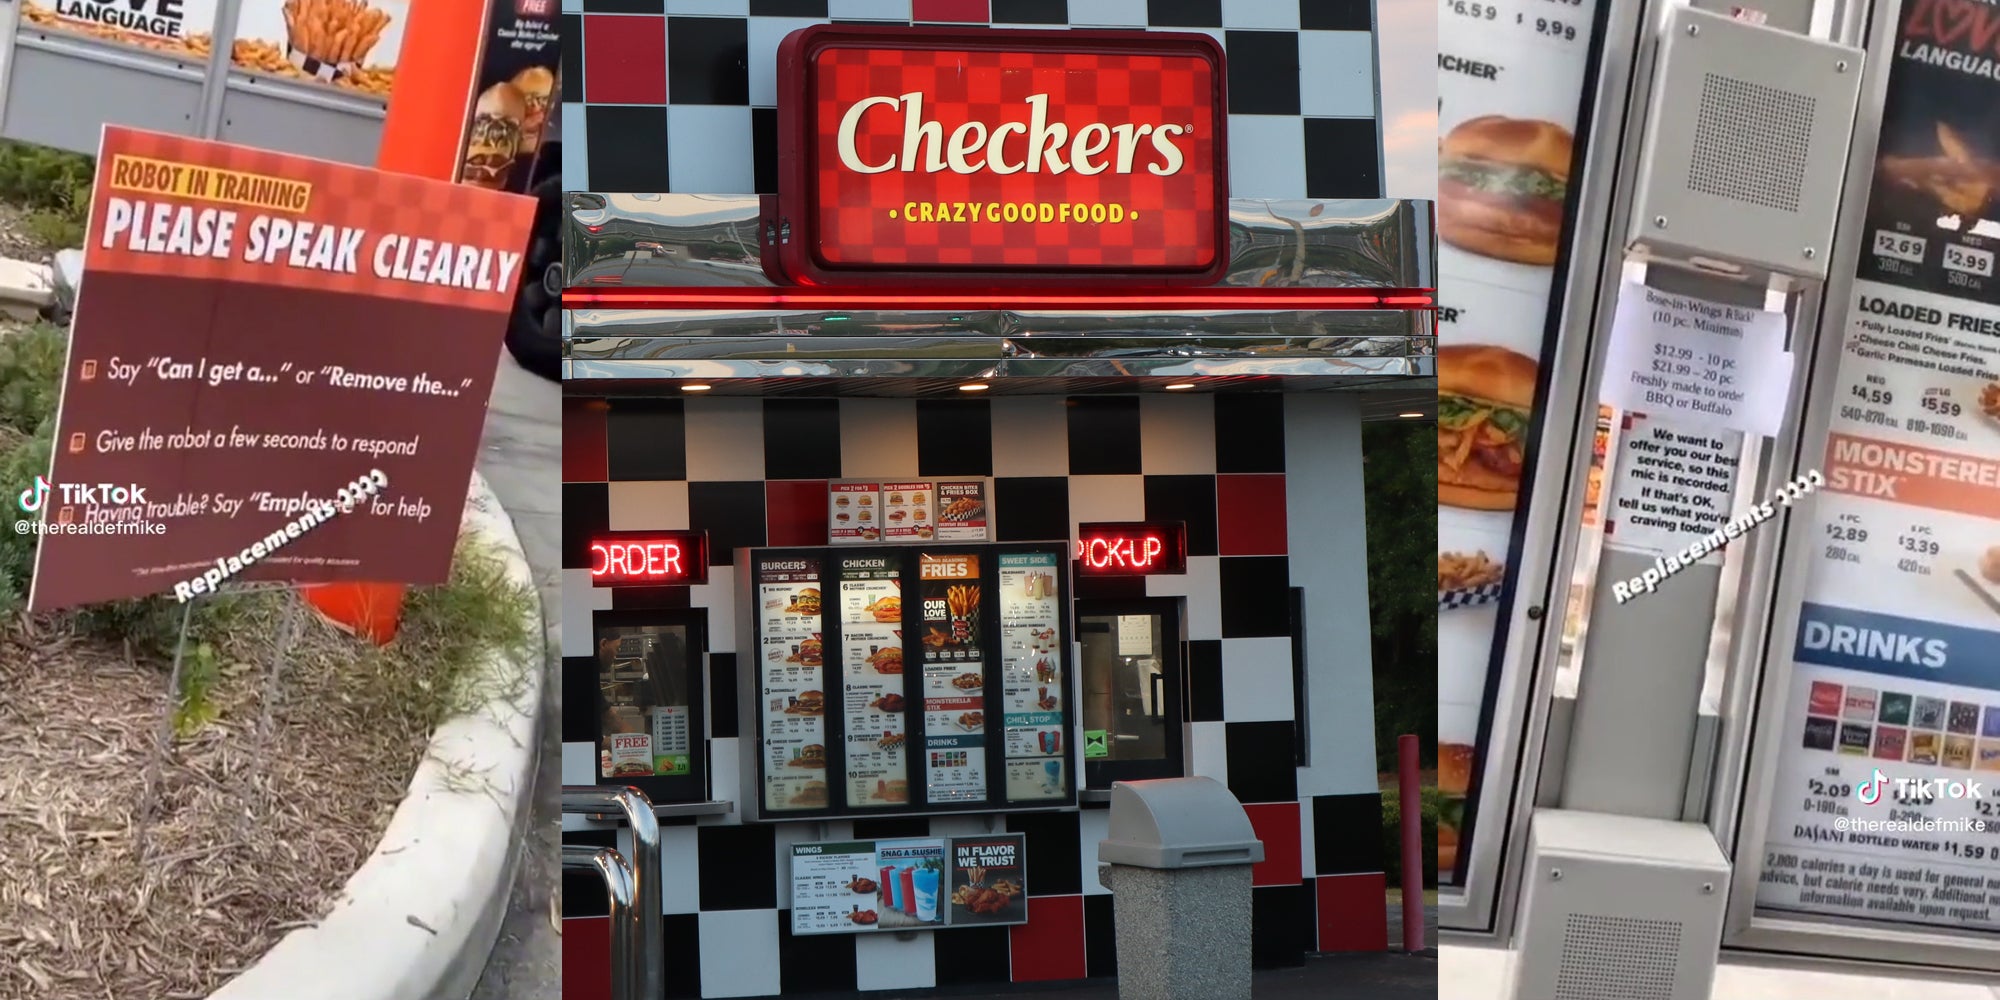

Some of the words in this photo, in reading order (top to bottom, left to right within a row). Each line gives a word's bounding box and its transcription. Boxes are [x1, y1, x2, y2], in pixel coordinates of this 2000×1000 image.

[56, 0, 181, 38] LANGUAGE
[114, 157, 182, 192] ROBOT
[187, 168, 208, 195] IN
[214, 172, 308, 210] TRAINING
[904, 202, 981, 222] CRAZY
[986, 202, 1055, 223] GOOD
[1059, 203, 1125, 223] FOOD
[102, 198, 236, 259] PLEASE
[245, 214, 366, 275] SPEAK
[373, 232, 521, 294] CLEARLY
[1880, 236, 1922, 255] $2.69
[1948, 249, 1987, 271] $2.99
[1859, 296, 1942, 325] LOADED
[1861, 320, 1885, 333] Fully
[1888, 325, 1922, 340] Loaded
[1654, 343, 1693, 360] $12.99
[1707, 353, 1721, 367] 10
[1859, 334, 1895, 348] Cheese
[1898, 340, 1920, 353] Chili
[1922, 346, 1958, 360] Cheese
[108, 356, 142, 386] Say
[197, 357, 206, 379] I
[208, 361, 244, 386] get
[296, 370, 315, 384] or
[1652, 359, 1690, 376] $21.99
[1703, 370, 1717, 382] 20
[1857, 348, 1886, 361] Garlic
[1888, 353, 1936, 369] Parmesan
[1938, 362, 1973, 377] Loaded
[1631, 371, 1668, 389] Freshly
[1672, 379, 1702, 395] made
[1704, 386, 1715, 397] to
[1646, 391, 1674, 408] BBQ
[1676, 397, 1689, 408] or
[1692, 400, 1732, 416] Buffalo
[1852, 385, 1892, 405] $4.59
[1922, 397, 1961, 417] $5.59
[96, 430, 135, 453] Give
[139, 426, 163, 450] the
[167, 426, 211, 449] robot
[214, 433, 226, 448] a
[229, 425, 259, 448] few
[263, 428, 327, 450] seconds
[332, 433, 347, 451] to
[352, 435, 419, 459] respond
[1630, 440, 1660, 454] offer
[1663, 446, 1687, 458] you
[1690, 449, 1712, 461] our
[1653, 428, 1673, 441] We
[1677, 435, 1708, 448] want
[1710, 438, 1723, 450] to
[1637, 455, 1685, 473] service,
[1688, 464, 1703, 475] so
[1706, 465, 1729, 479] this
[1631, 468, 1656, 482] mic
[1658, 471, 1669, 483] is
[1672, 474, 1730, 494] recorded.
[147, 493, 209, 518] trouble?
[212, 493, 244, 518] Say
[370, 494, 394, 516] for
[397, 497, 431, 524] help
[1641, 486, 1652, 498] If
[1653, 489, 1689, 505] that's
[1692, 495, 1715, 509] OK,
[1619, 498, 1639, 511] tell
[1641, 502, 1658, 512] us
[1660, 504, 1691, 518] what
[1695, 510, 1730, 526] you'r
[1630, 514, 1677, 533] craving
[1826, 524, 1868, 542] $2.89
[1898, 536, 1940, 555] $3.39
[843, 560, 885, 568] CHICKEN
[1825, 545, 1847, 560] 280
[761, 561, 806, 570] BURGERS
[922, 563, 968, 577] FRIES
[924, 600, 946, 609] OUR
[924, 609, 946, 617] LOVE
[1803, 620, 1948, 669] DRINKS
[615, 737, 649, 748] FREE
[1808, 778, 1851, 797] $2.09
[795, 846, 822, 854] WINGS
[912, 848, 942, 856] SLUSHIE
[957, 848, 970, 857] IN
[972, 846, 1015, 856] FLAVOR
[1793, 825, 1845, 844] DASANI
[1848, 835, 1899, 848] BOTTLED
[1902, 840, 1939, 852] WATER
[1945, 841, 1985, 859] $1.59
[958, 858, 977, 867] WE
[980, 856, 1015, 867] TRUST
[1801, 858, 1845, 874] calories
[1860, 863, 1879, 880] day
[1882, 865, 1892, 879] is
[1896, 868, 1922, 882] used
[1925, 869, 1940, 883] for
[1943, 874, 1984, 888] general
[1759, 870, 1798, 886] advice,
[1803, 872, 1822, 888] but
[1825, 877, 1863, 892] calorie
[1867, 882, 1899, 895] needs
[1903, 886, 1928, 900] vary.
[1932, 887, 1986, 904] Additional
[1800, 891, 1864, 907] information
[1867, 897, 1915, 913] available
[1919, 904, 1945, 917] upon
[1949, 907, 1991, 920] request.
